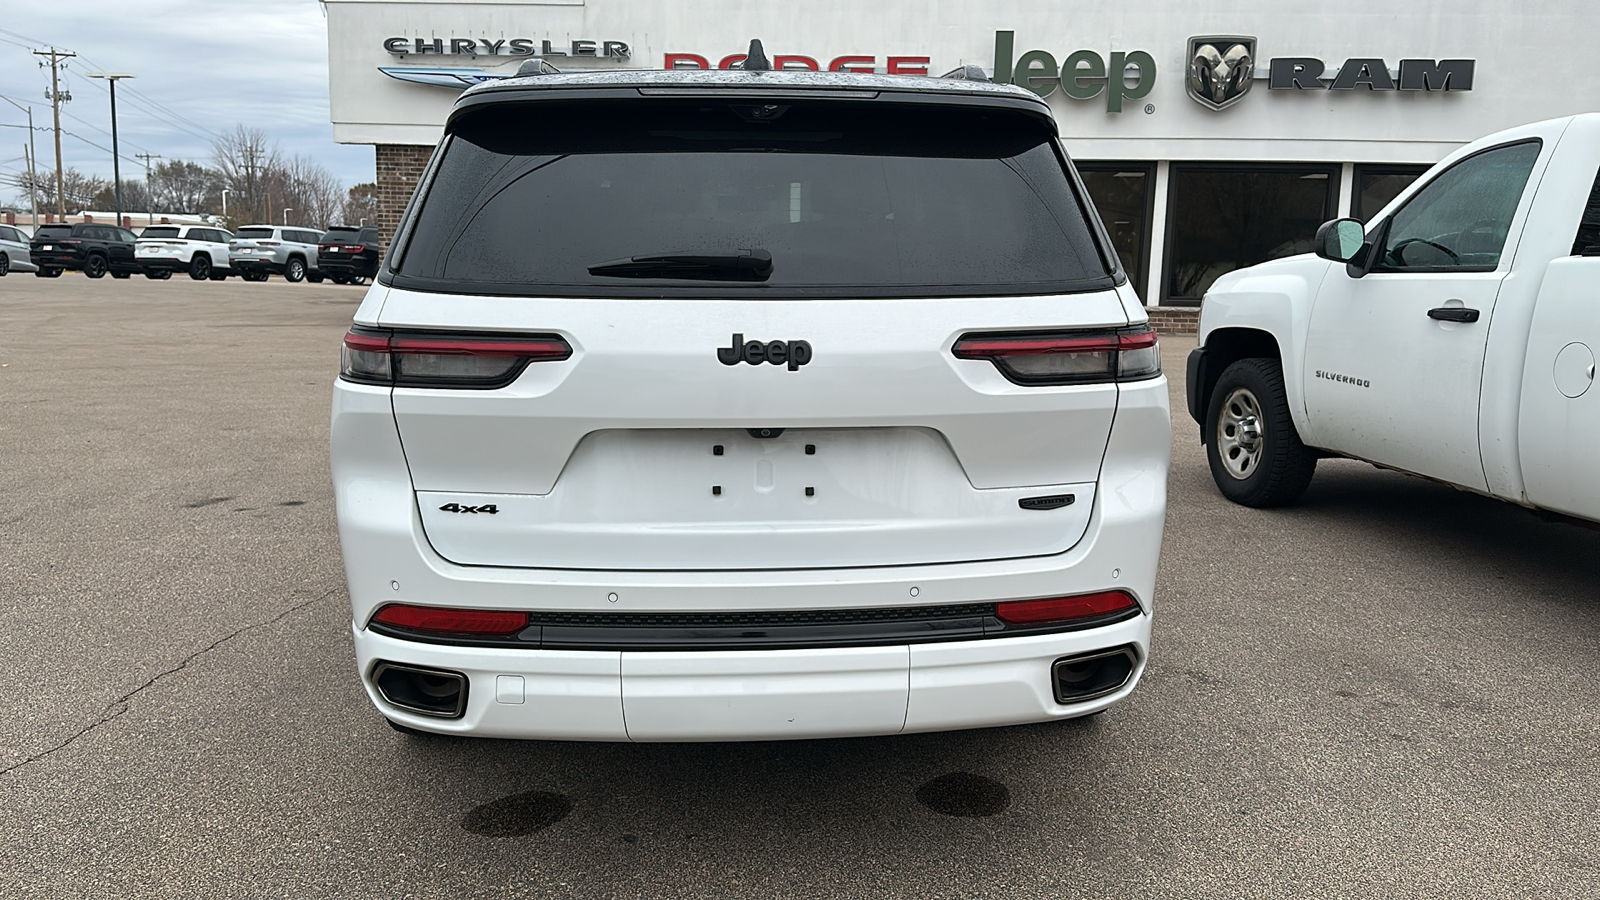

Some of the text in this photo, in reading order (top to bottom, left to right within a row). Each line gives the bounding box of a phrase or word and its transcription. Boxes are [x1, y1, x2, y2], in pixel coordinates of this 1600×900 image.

[383, 37, 631, 58] CHRYSLER
[664, 53, 931, 75] DDGE
[1268, 57, 1476, 92] RAM
[717, 333, 812, 371] Jeep
[1315, 370, 1370, 388] SILVERADO
[438, 502, 500, 515] 4x4
